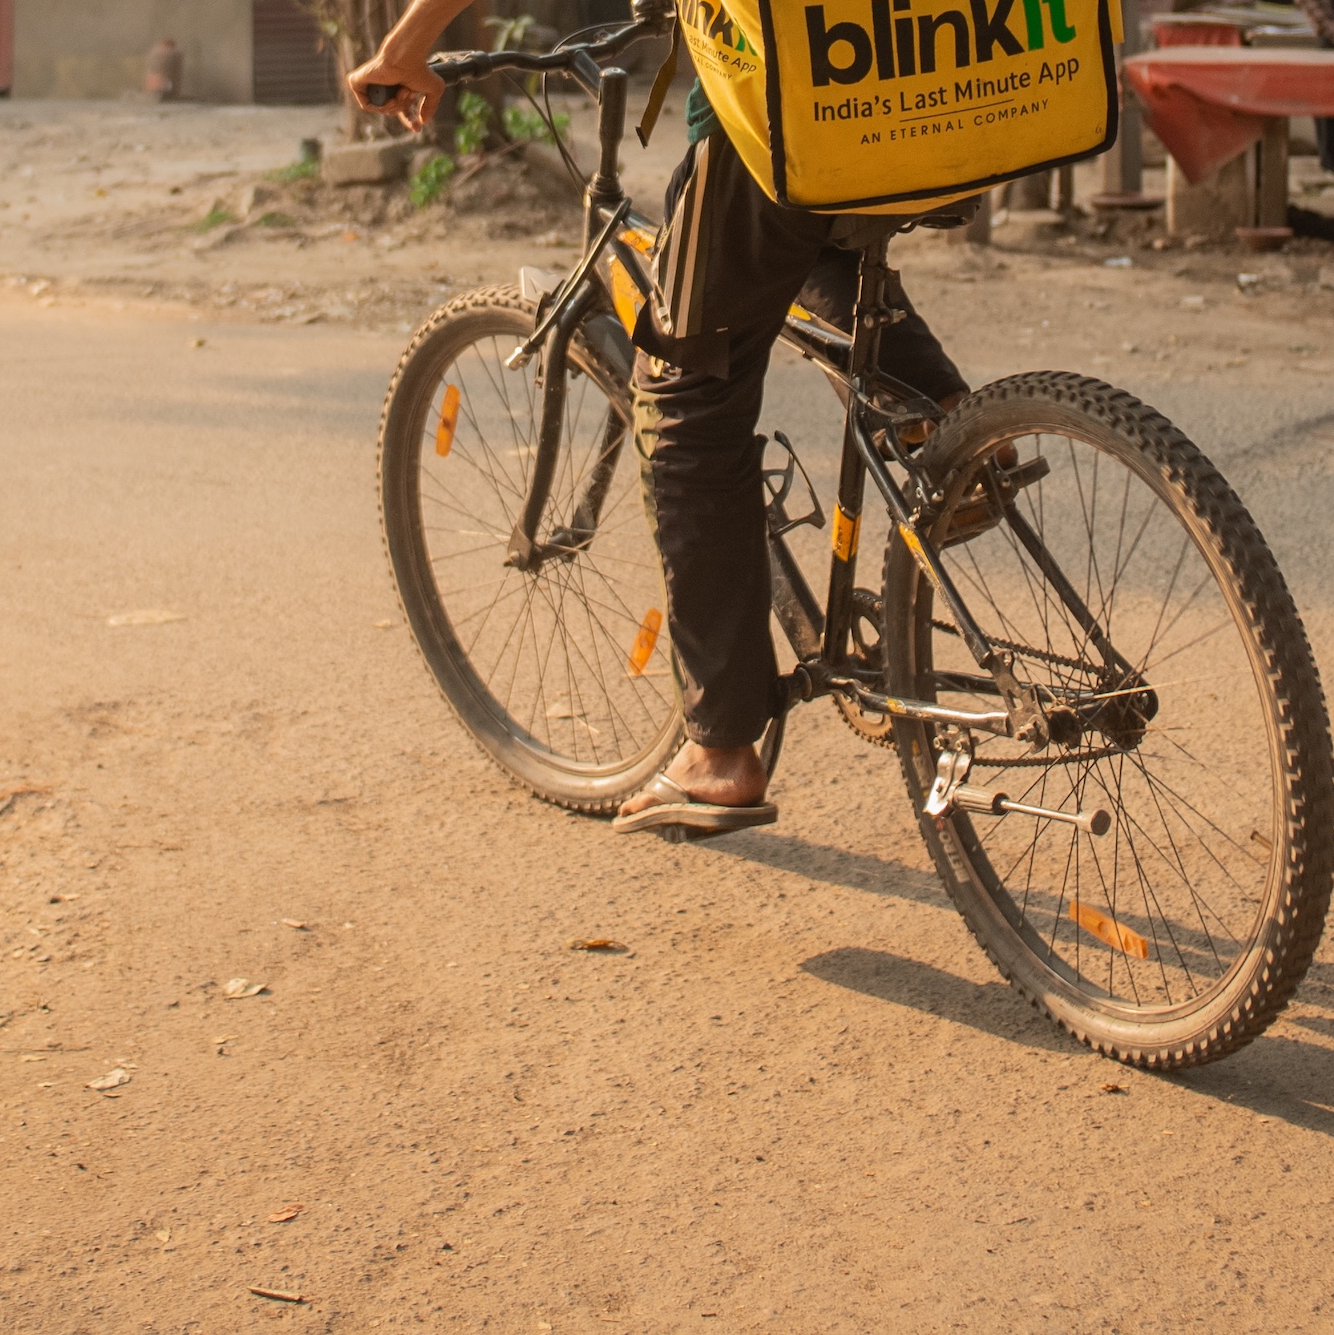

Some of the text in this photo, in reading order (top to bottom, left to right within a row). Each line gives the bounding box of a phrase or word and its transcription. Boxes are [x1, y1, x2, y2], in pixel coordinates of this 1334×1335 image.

[731, 56, 758, 73] App
[814, 57, 1080, 121] India's Last Minute App
[860, 98, 1049, 145] AN ETERNAL COMPANY
